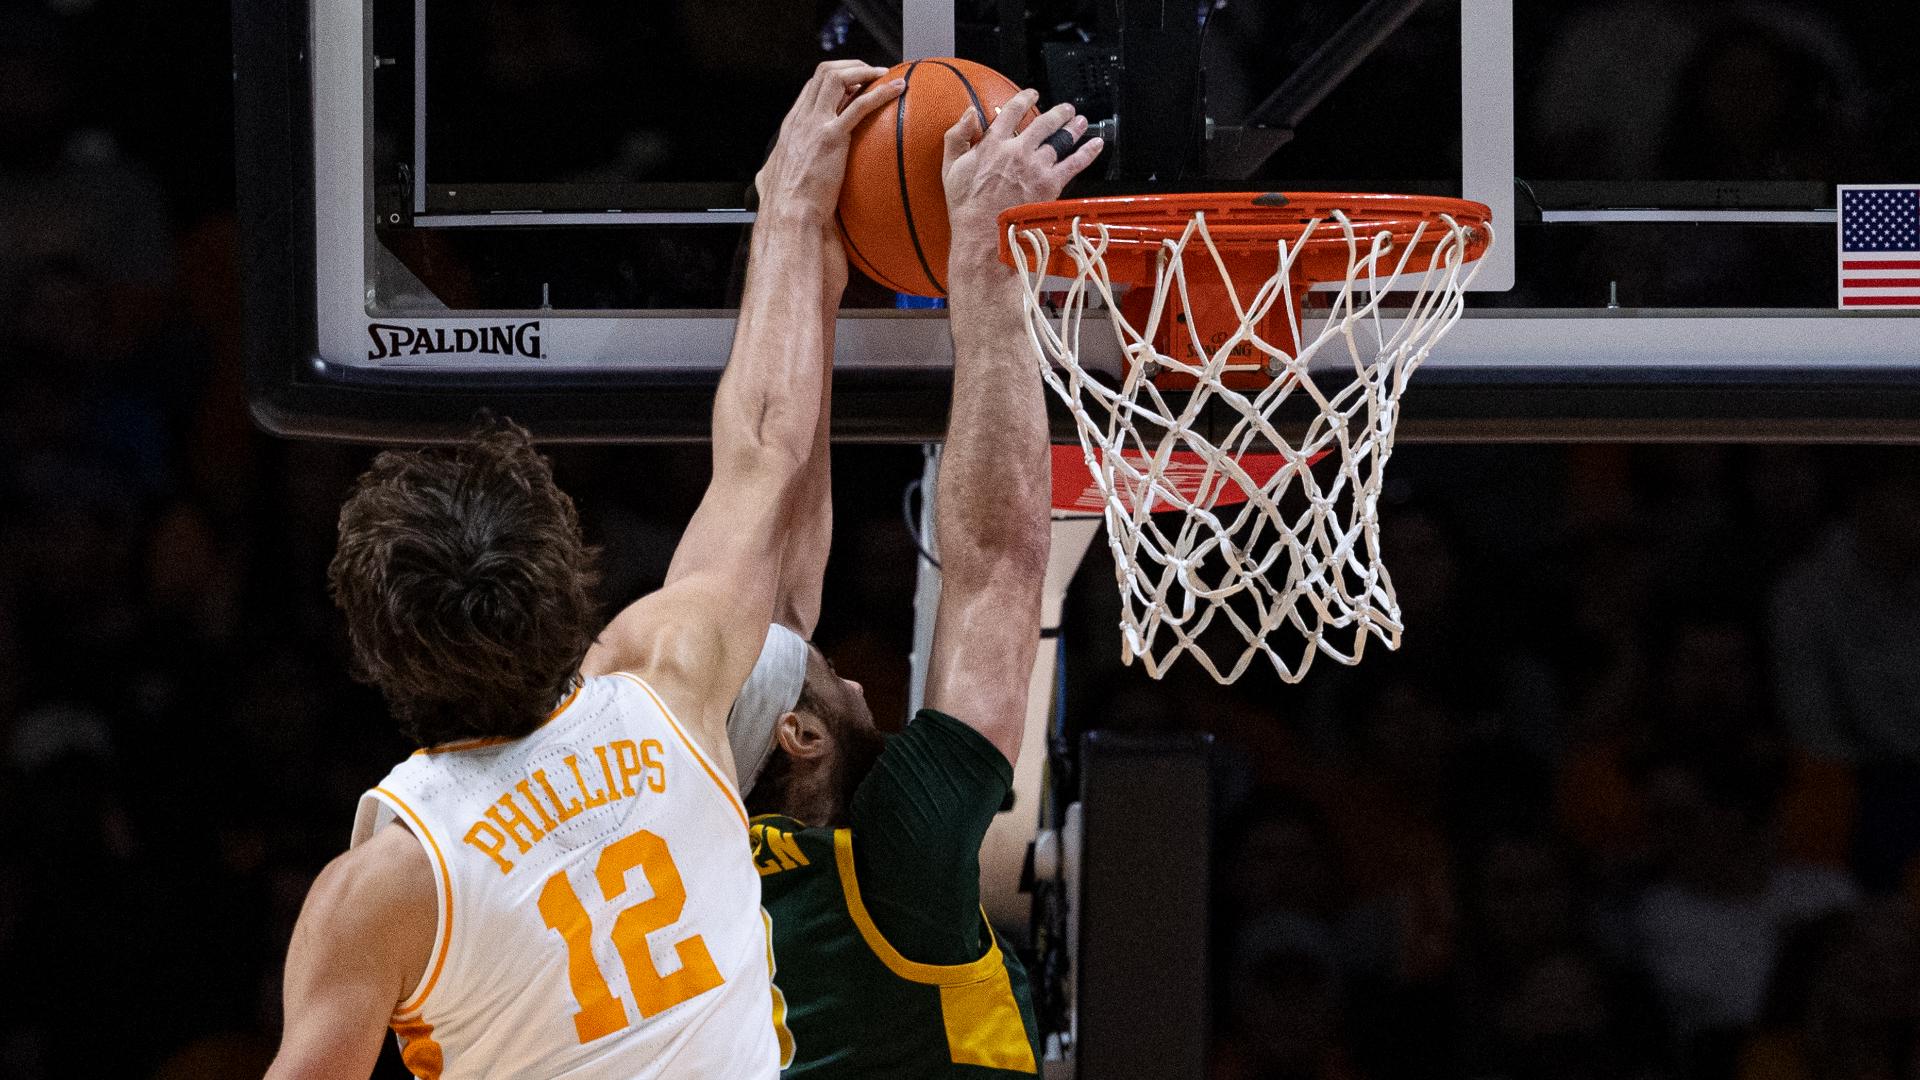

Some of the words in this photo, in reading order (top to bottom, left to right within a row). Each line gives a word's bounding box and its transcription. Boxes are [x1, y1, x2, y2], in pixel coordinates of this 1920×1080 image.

[368, 321, 541, 360] SPALDING
[463, 739, 666, 875] PHILLIPS
[537, 829, 726, 1045] 12
